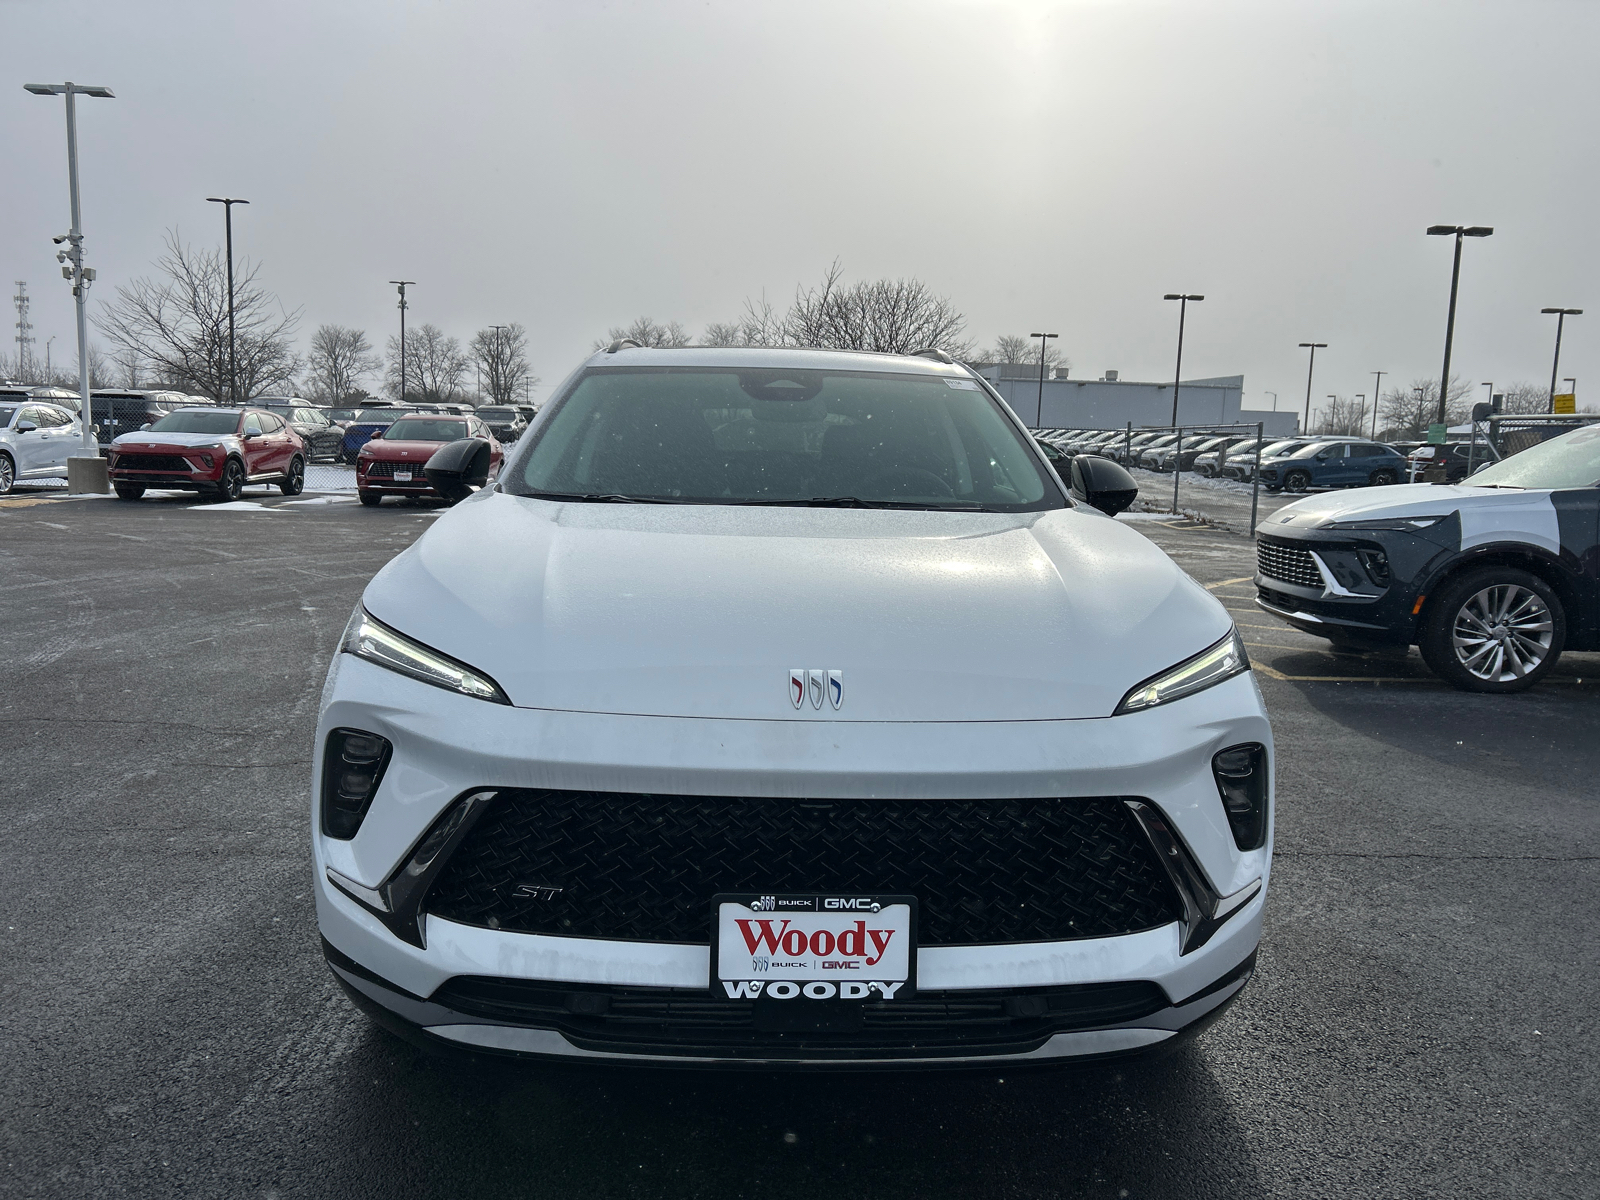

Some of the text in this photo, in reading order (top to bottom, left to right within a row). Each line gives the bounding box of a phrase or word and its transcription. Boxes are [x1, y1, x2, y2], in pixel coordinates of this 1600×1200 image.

[512, 884, 563, 900] ST
[824, 898, 871, 909] GMC
[734, 919, 896, 966] Woody
[822, 961, 860, 970] GMC
[722, 982, 905, 999] WOODY
